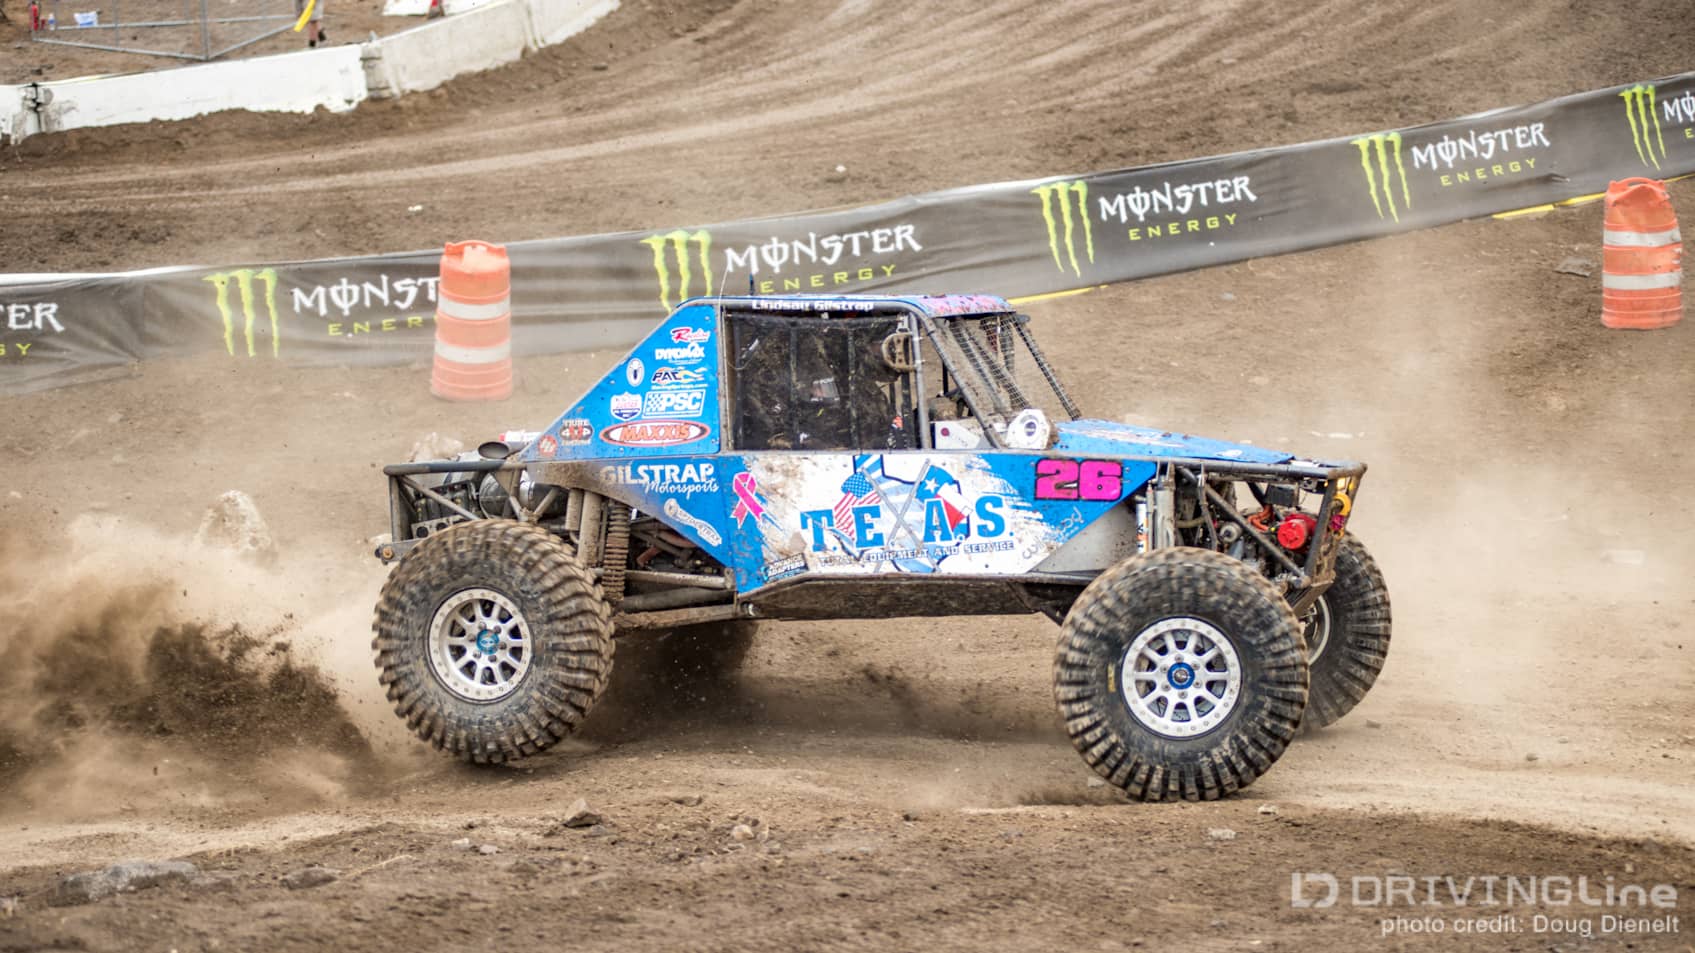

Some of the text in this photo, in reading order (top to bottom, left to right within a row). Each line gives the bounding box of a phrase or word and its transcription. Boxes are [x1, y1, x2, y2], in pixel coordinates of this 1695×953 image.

[1411, 122, 1551, 171] MONSTER
[1440, 158, 1536, 187] ENERGY
[1098, 175, 1257, 224] MONSTER
[1128, 213, 1237, 241] ENERGY
[725, 223, 922, 276] MONSTER
[760, 264, 896, 294] ENERGY
[814, 299, 874, 312] Gilstrap
[328, 315, 437, 336] ENER
[652, 371, 682, 382] PAC
[661, 391, 702, 412] PSC
[620, 423, 690, 441] MAXXIS
[602, 463, 714, 485] GILSTRAP
[1034, 458, 1124, 500] 26
[645, 478, 720, 499] Motorsports
[934, 545, 960, 558] AND
[963, 541, 1015, 555] SERVICE
